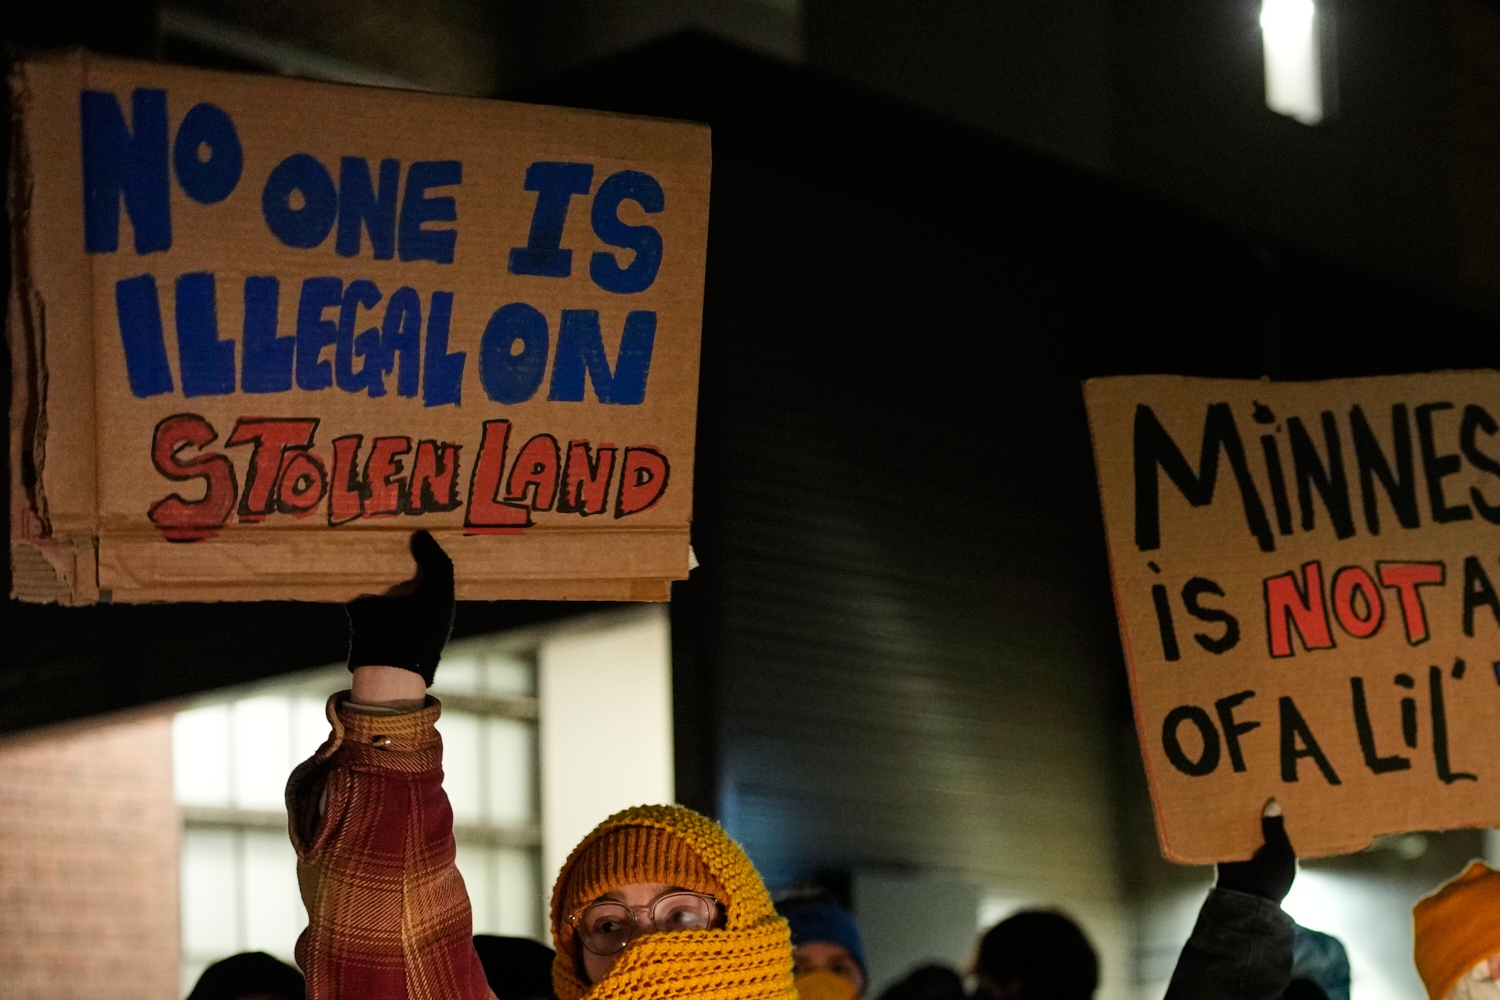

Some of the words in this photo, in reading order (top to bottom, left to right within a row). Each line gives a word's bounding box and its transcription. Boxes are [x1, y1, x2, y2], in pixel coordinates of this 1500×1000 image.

[79, 87, 244, 255] NO
[261, 153, 464, 264] ONE
[507, 160, 666, 294] IS
[115, 271, 467, 408] ILLEGAL
[478, 302, 658, 406] ON
[147, 412, 464, 543] STOLEN
[462, 418, 672, 536] LAND
[1262, 559, 1446, 659] NOT
[1161, 690, 1261, 778] OF
[1278, 695, 1342, 786] A
